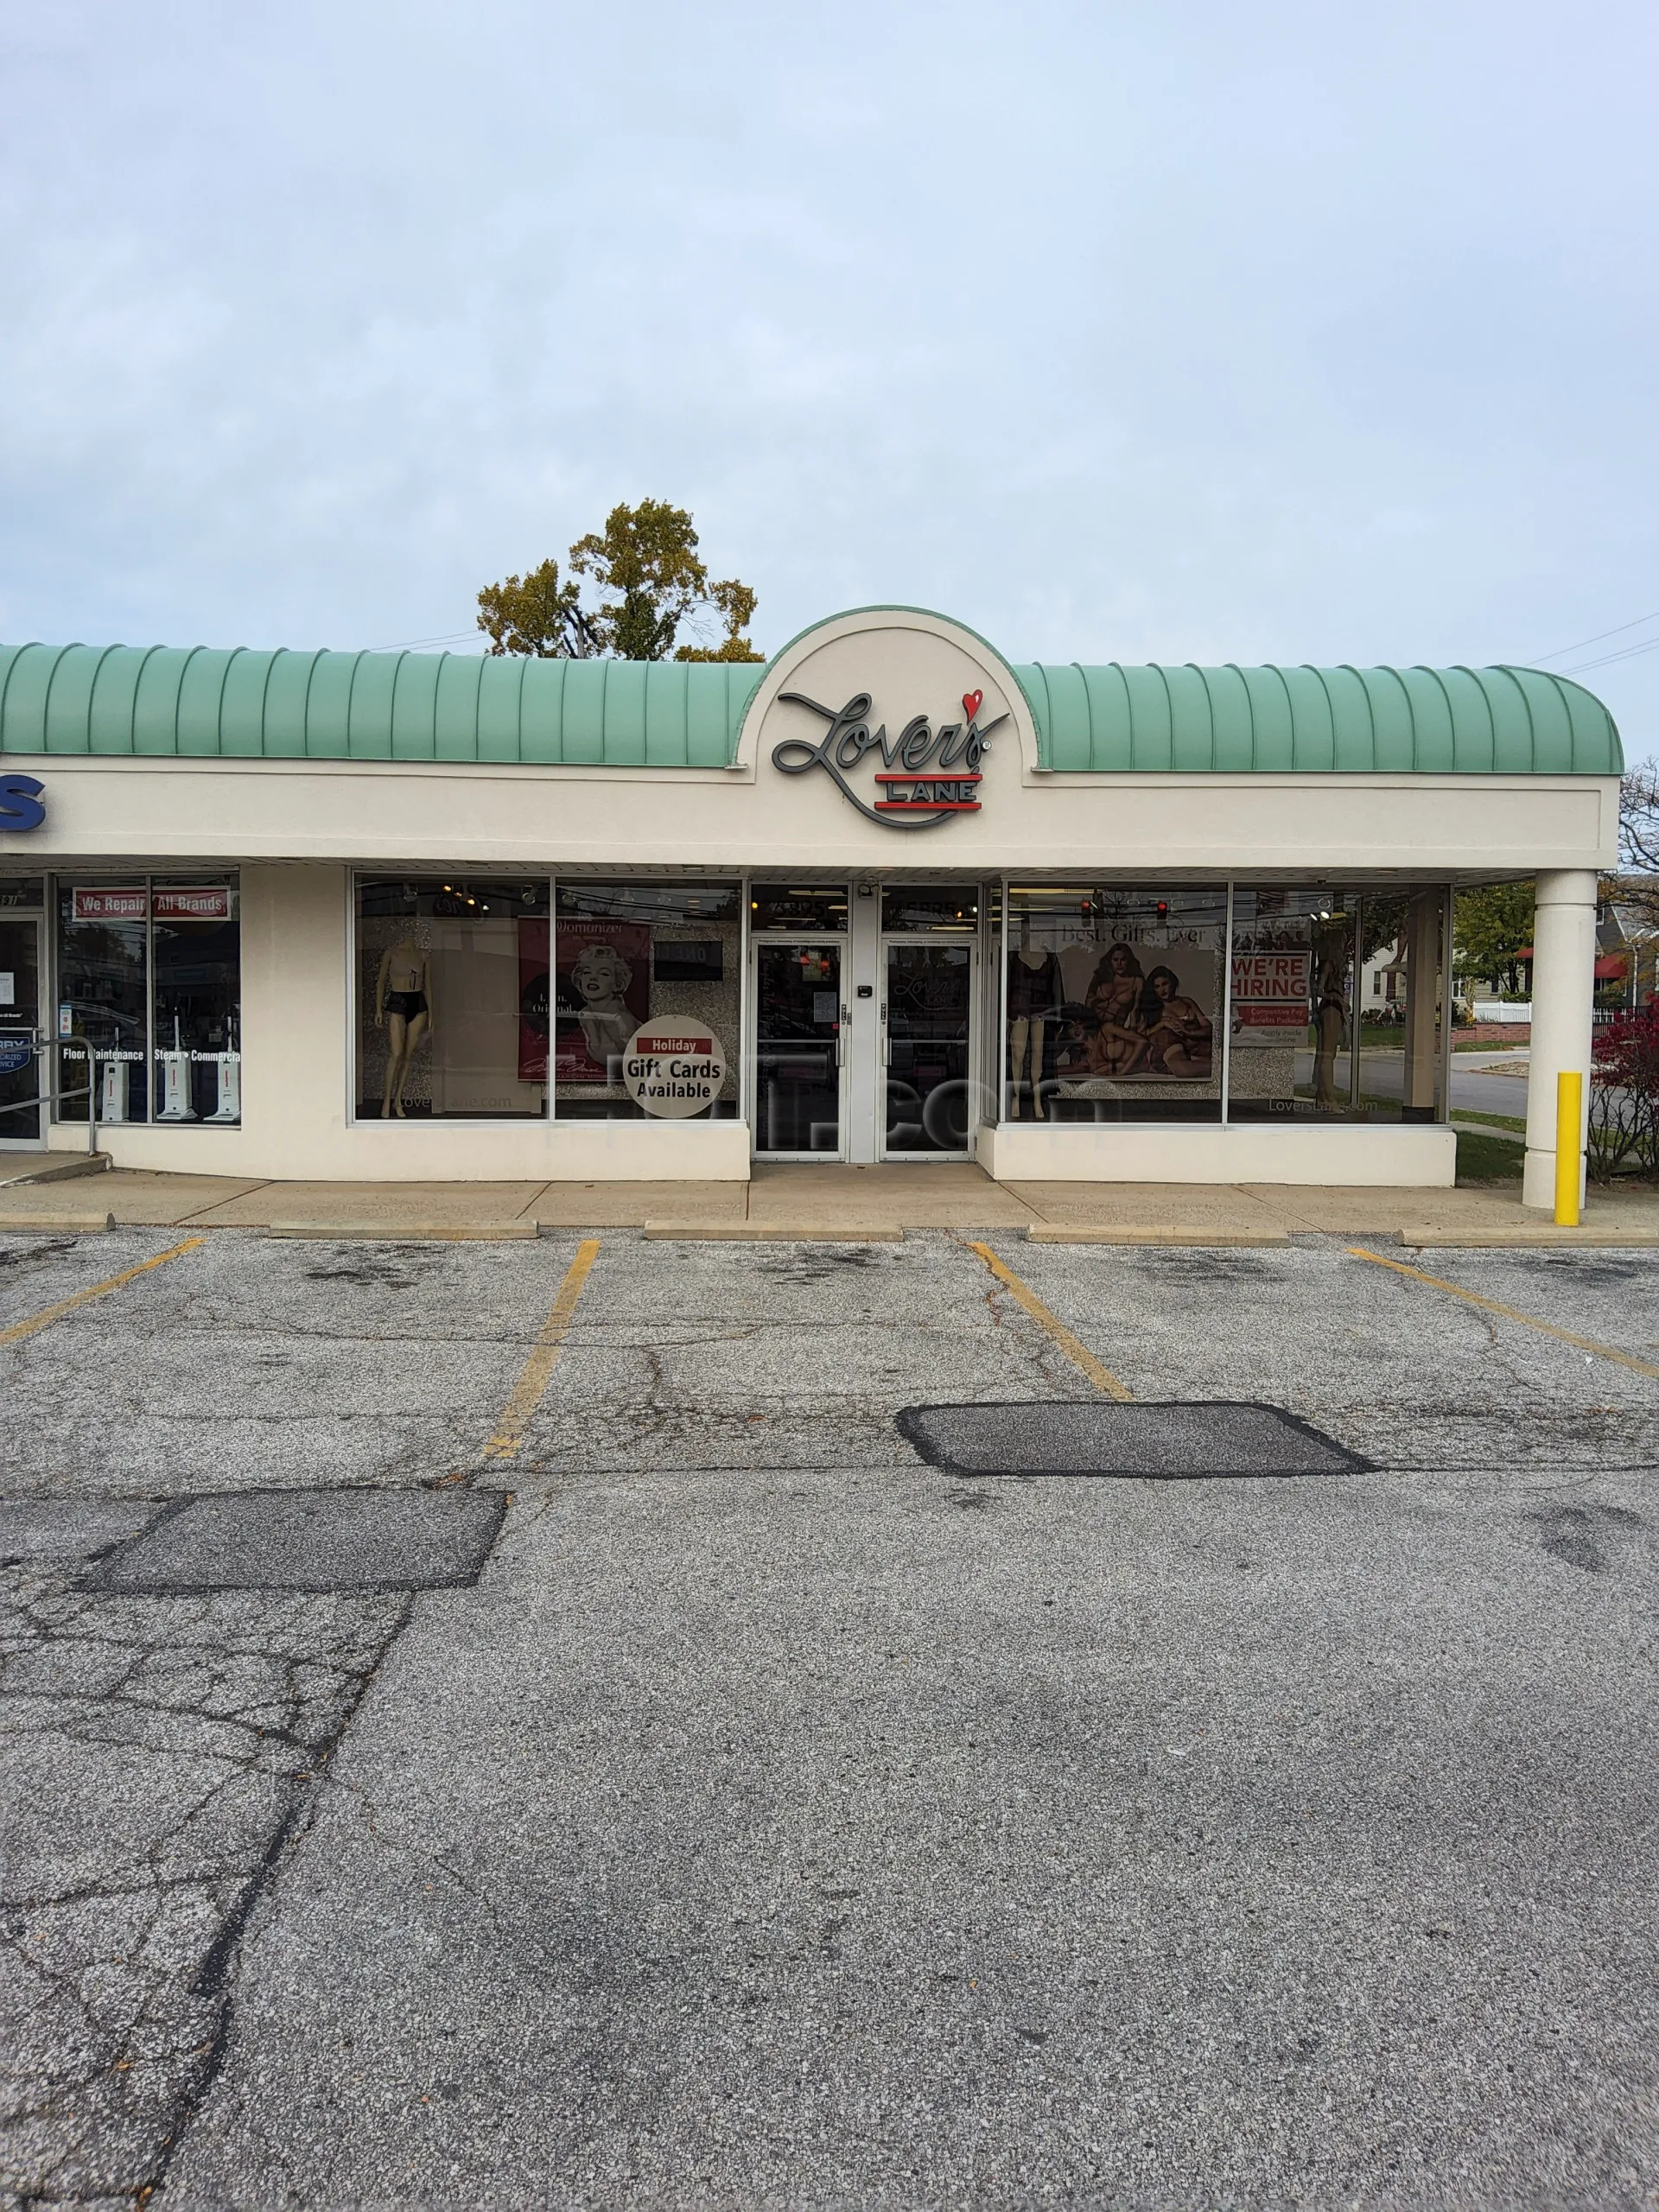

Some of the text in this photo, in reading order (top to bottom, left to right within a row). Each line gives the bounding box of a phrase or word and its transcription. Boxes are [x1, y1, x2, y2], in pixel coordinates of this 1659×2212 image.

[886, 781, 977, 802] LANE
[0, 774, 46, 832] S
[82, 895, 223, 914] We Repair All Brands
[556, 919, 623, 934] Womanizer
[1231, 958, 1303, 976] WE'RE
[1230, 978, 1307, 997] HIRING
[532, 1002, 576, 1014] Orinal.
[1250, 1007, 1304, 1018] Competitive Pay
[63, 1047, 86, 1059] Floor
[154, 1049, 181, 1061] Steam
[652, 1039, 697, 1053] Holiday
[627, 1058, 662, 1079] Gift
[670, 1058, 721, 1079] Cards
[637, 1082, 711, 1099] Available
[1268, 1098, 1378, 1111] LoversLae.com
